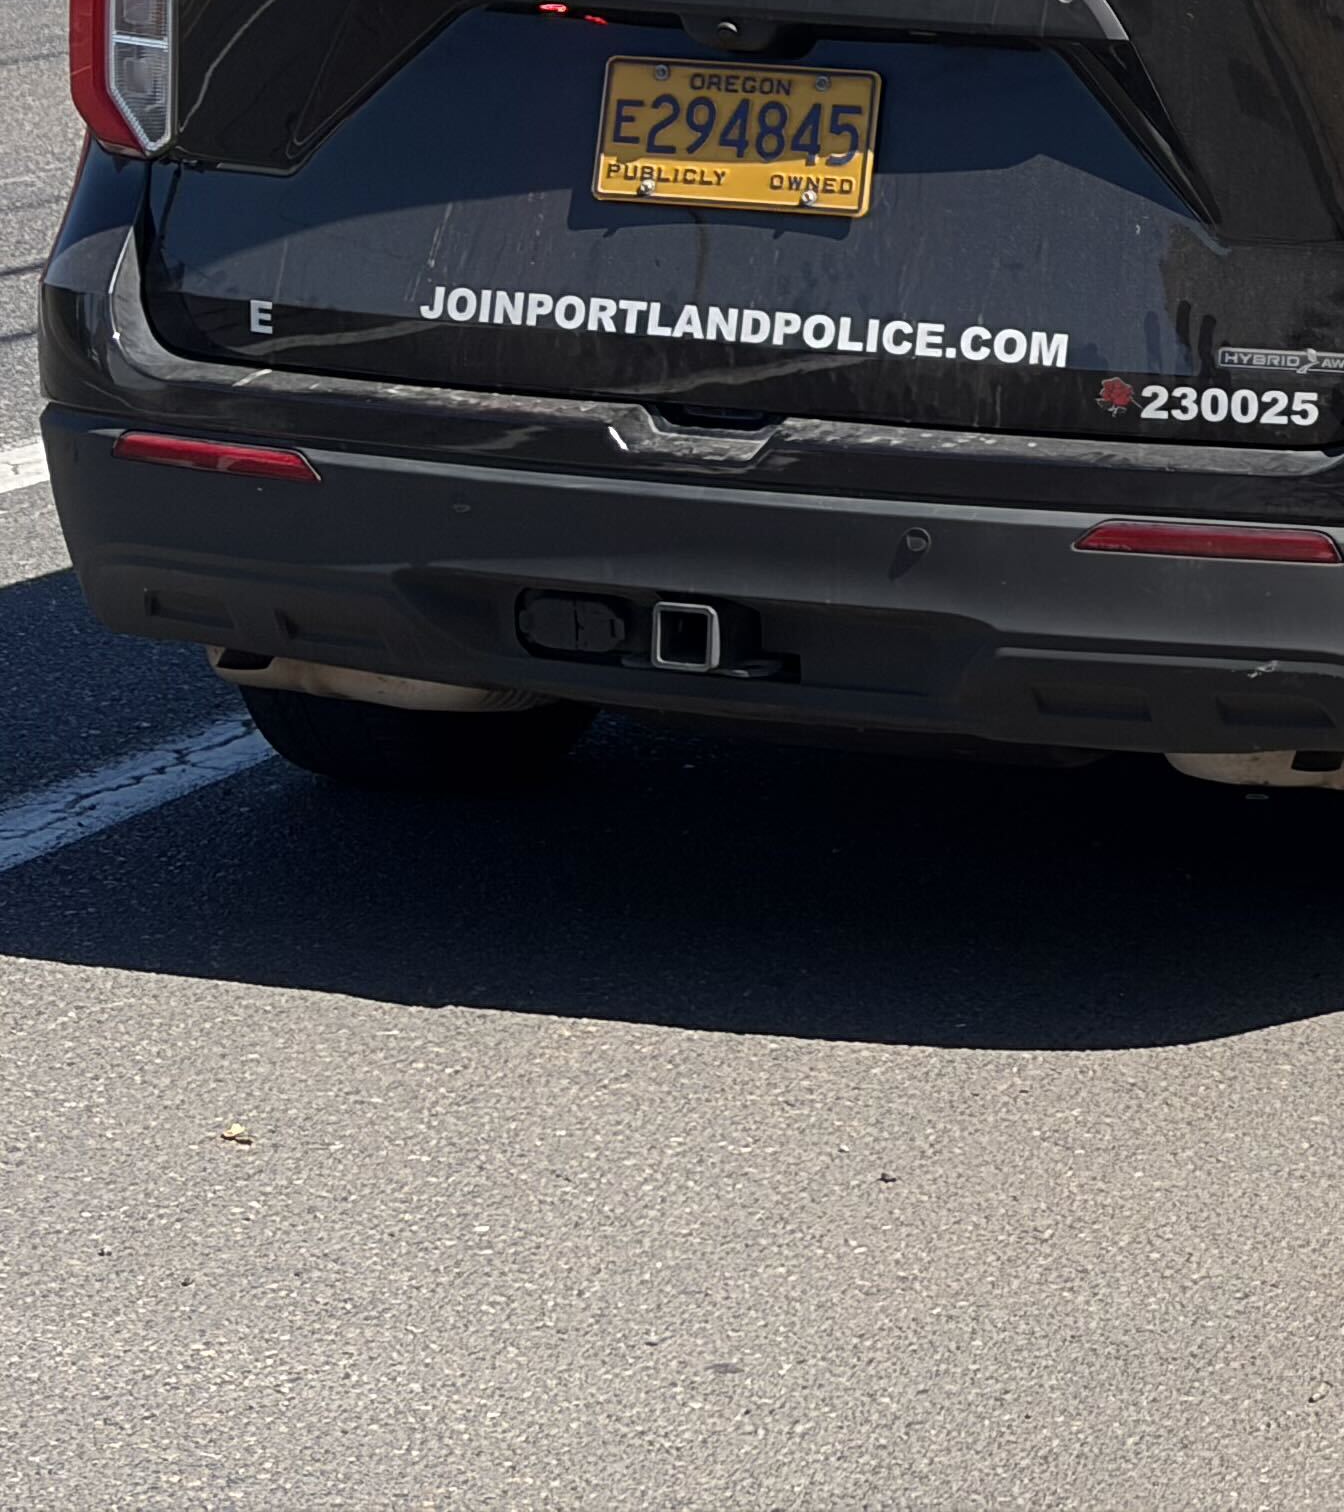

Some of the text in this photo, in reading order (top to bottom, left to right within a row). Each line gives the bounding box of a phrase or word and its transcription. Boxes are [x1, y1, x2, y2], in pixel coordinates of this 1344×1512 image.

[690, 72, 793, 96] OREGON
[612, 93, 863, 167] E294845
[606, 163, 855, 195] PUBLICLY OWNED
[250, 286, 1069, 367] E JOINPORTLANDPOLICE.COM
[1224, 352, 1300, 367] HYBRID
[1140, 384, 1319, 426] 230025
